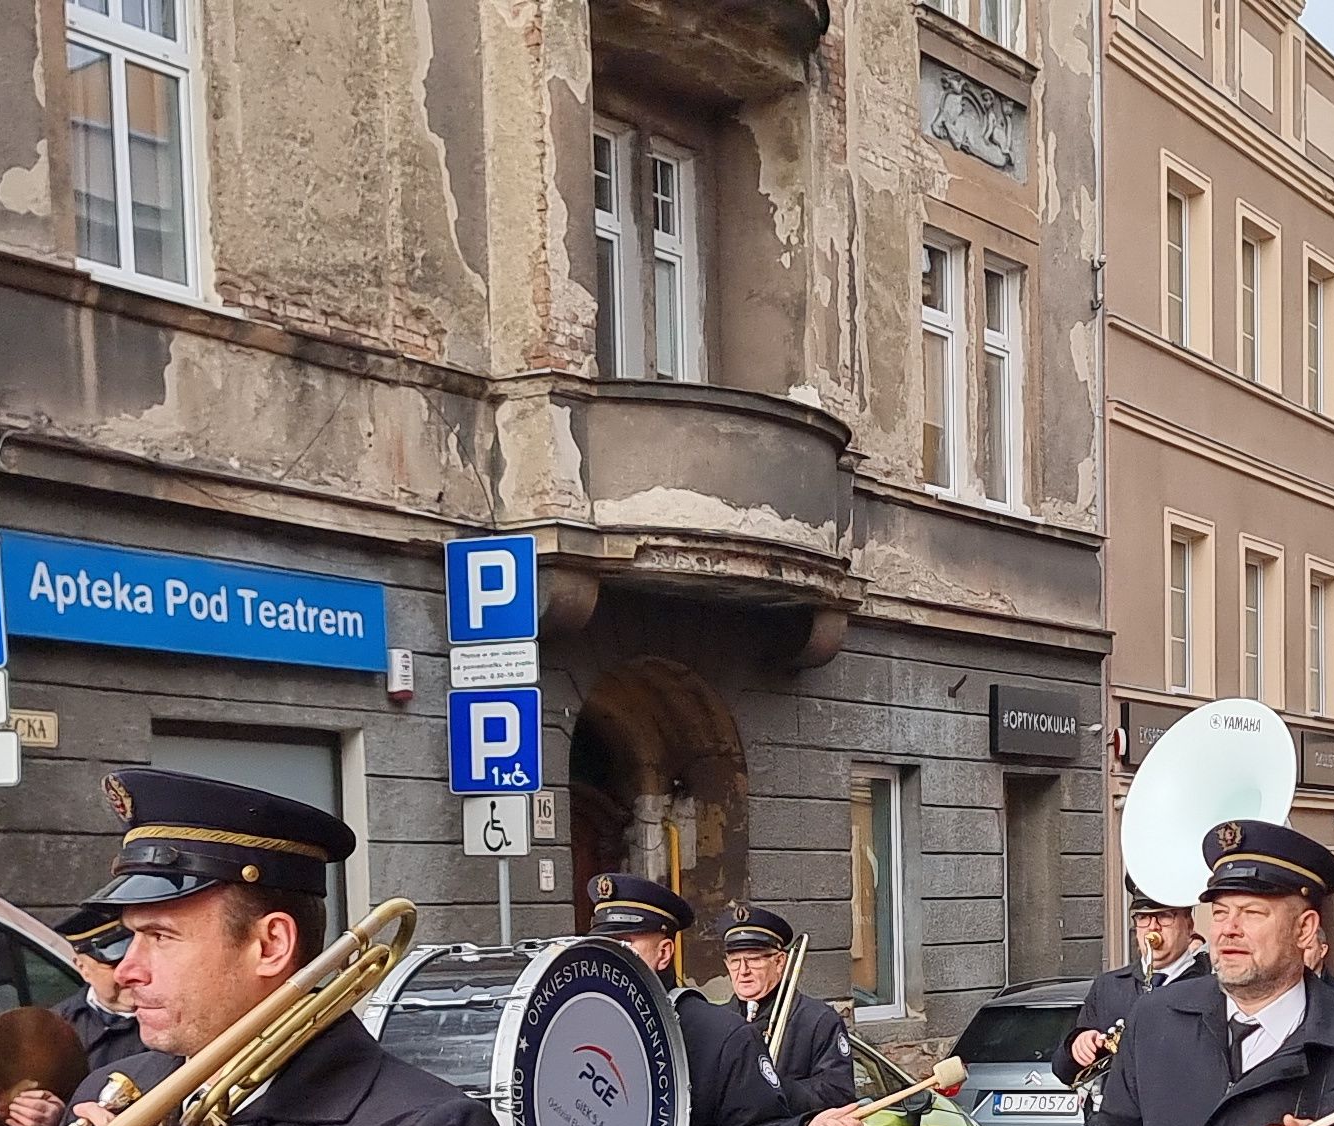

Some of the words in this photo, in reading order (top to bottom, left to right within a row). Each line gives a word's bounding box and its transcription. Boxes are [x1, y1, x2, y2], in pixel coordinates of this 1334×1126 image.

[29, 561, 154, 615] Apteka
[165, 578, 228, 624] Pod
[237, 588, 364, 639] Teatrem
[467, 549, 517, 629] P
[470, 702, 520, 780] P
[1223, 715, 1261, 733] YAMAHA
[537, 798, 552, 818] 16
[527, 960, 600, 1026] ORKIESTRA
[578, 1062, 619, 1108] PGE
[1003, 1096, 1023, 1110] DJ
[1028, 1096, 1075, 1110] 70576
